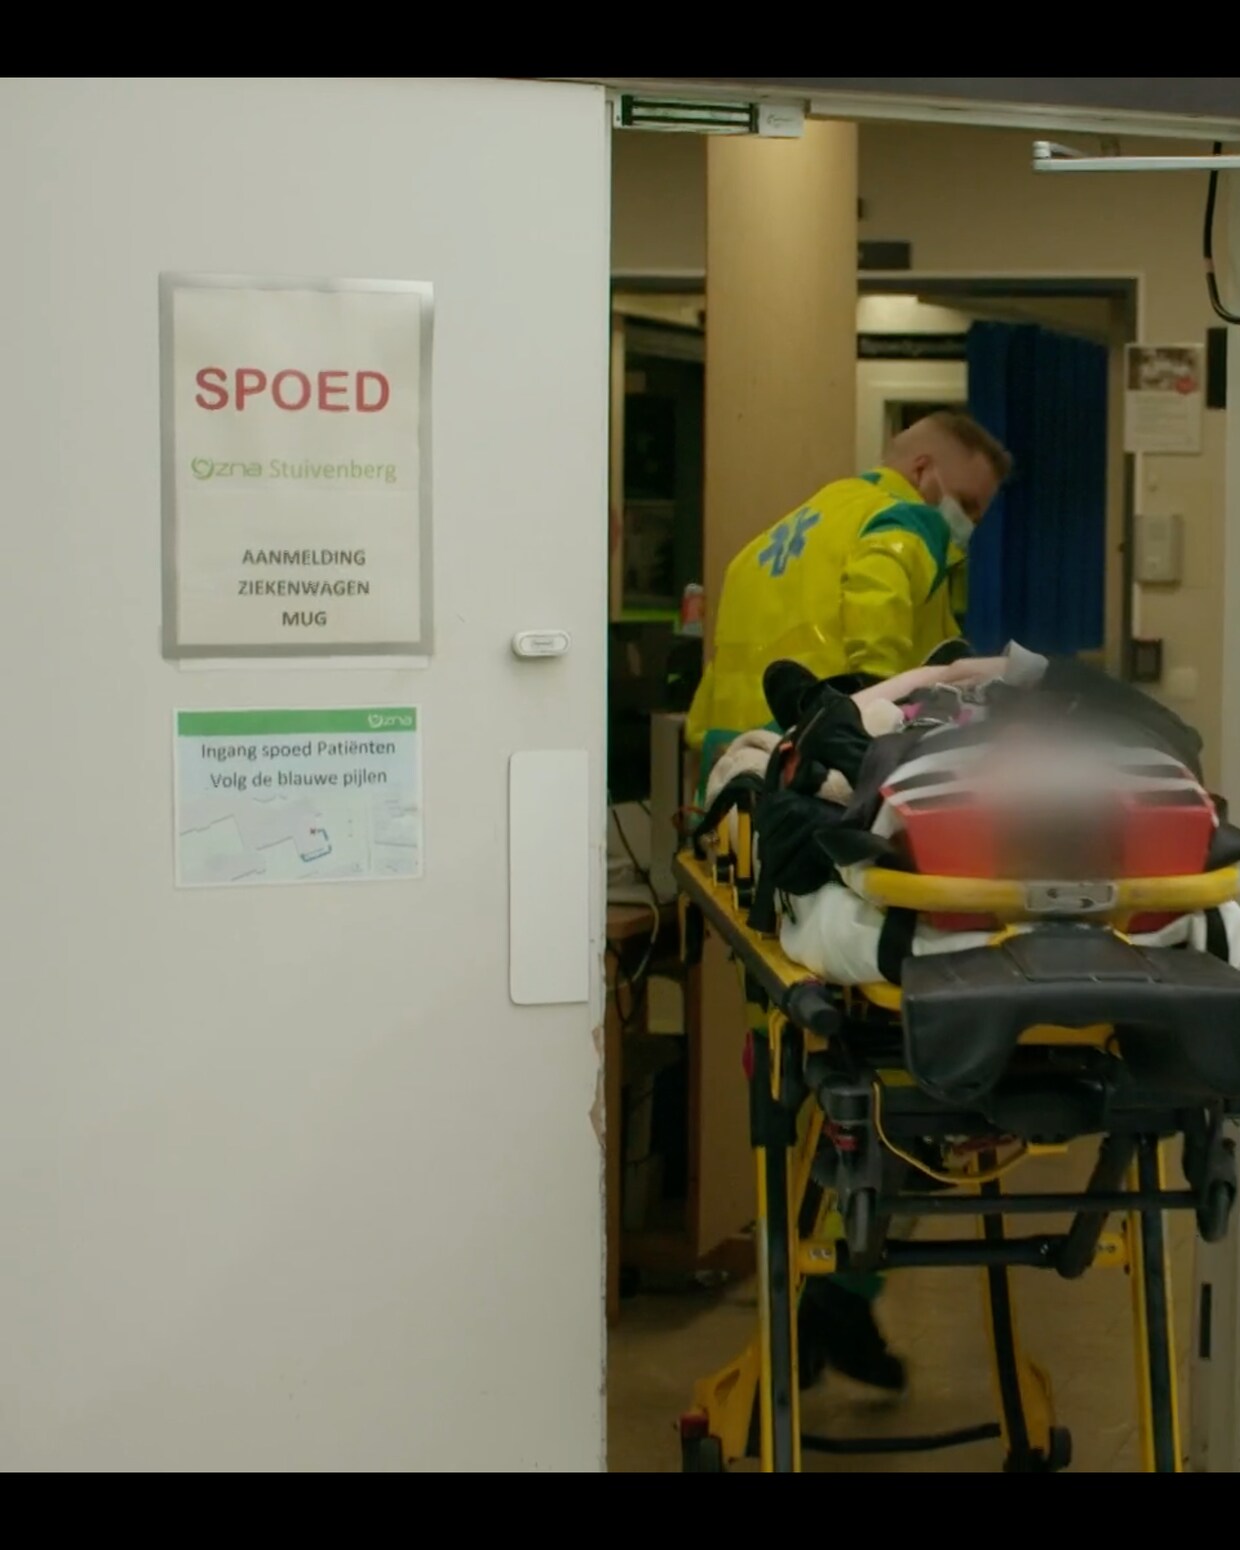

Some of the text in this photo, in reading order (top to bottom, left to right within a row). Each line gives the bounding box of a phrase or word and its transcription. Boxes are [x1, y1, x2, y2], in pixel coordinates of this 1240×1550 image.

[194, 366, 390, 413] SPOED
[269, 458, 397, 484] Stuivenberg
[241, 548, 367, 566] AANMELDING
[237, 579, 370, 597] ZIEKENWAGEN
[281, 610, 328, 627] MUG
[201, 740, 396, 762] Ingang spoed Patiënten
[210, 768, 387, 791] Volg de blauwe pijlen
